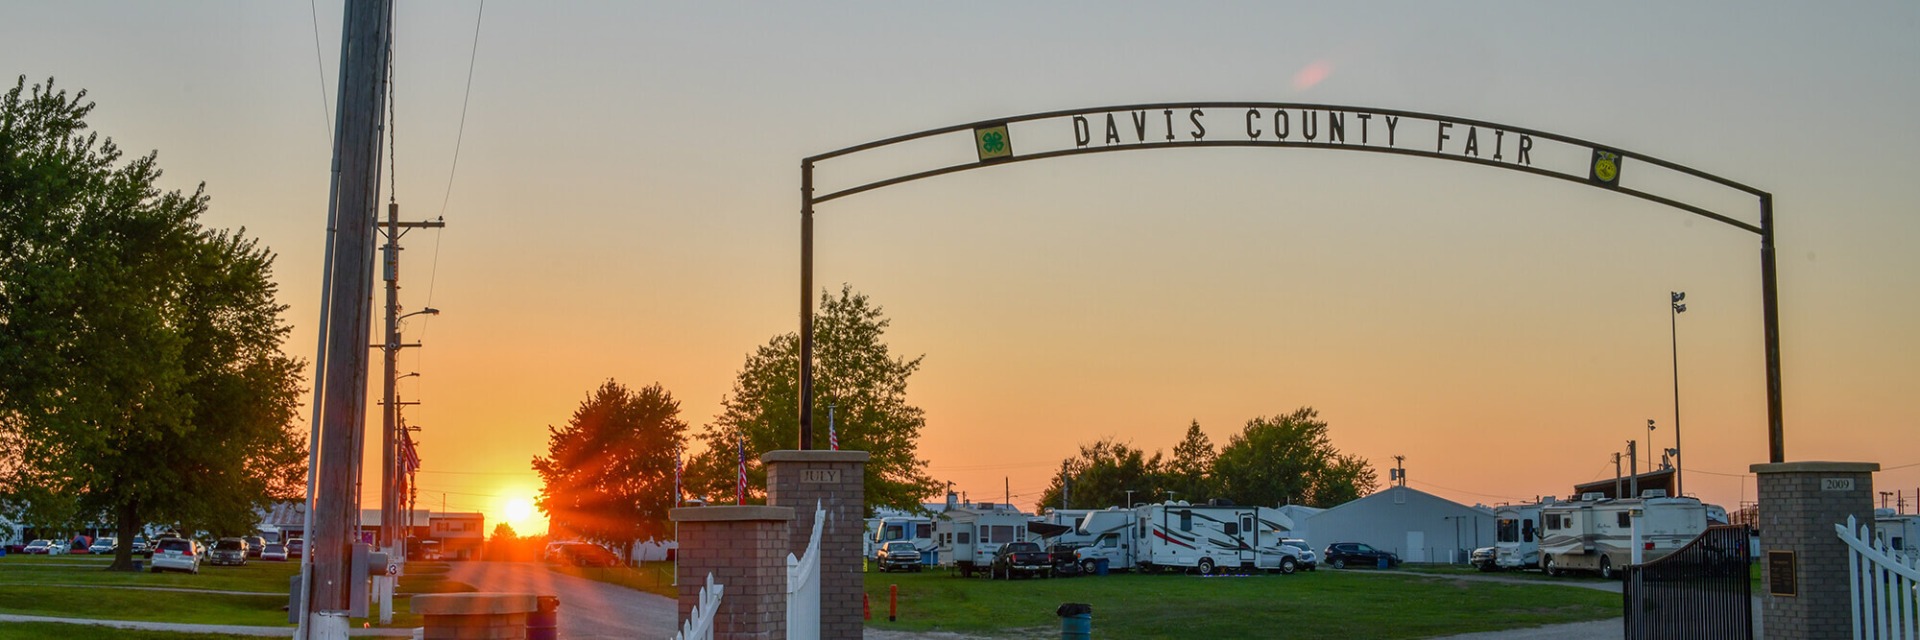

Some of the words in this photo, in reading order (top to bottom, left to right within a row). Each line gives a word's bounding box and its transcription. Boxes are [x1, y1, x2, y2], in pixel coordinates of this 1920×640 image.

[1073, 109, 1205, 145] DAVIS
[1246, 109, 1399, 144] COUNTY
[1439, 122, 1533, 165] FAIR
[804, 470, 836, 481] JULY
[1826, 479, 1849, 489] 2009
